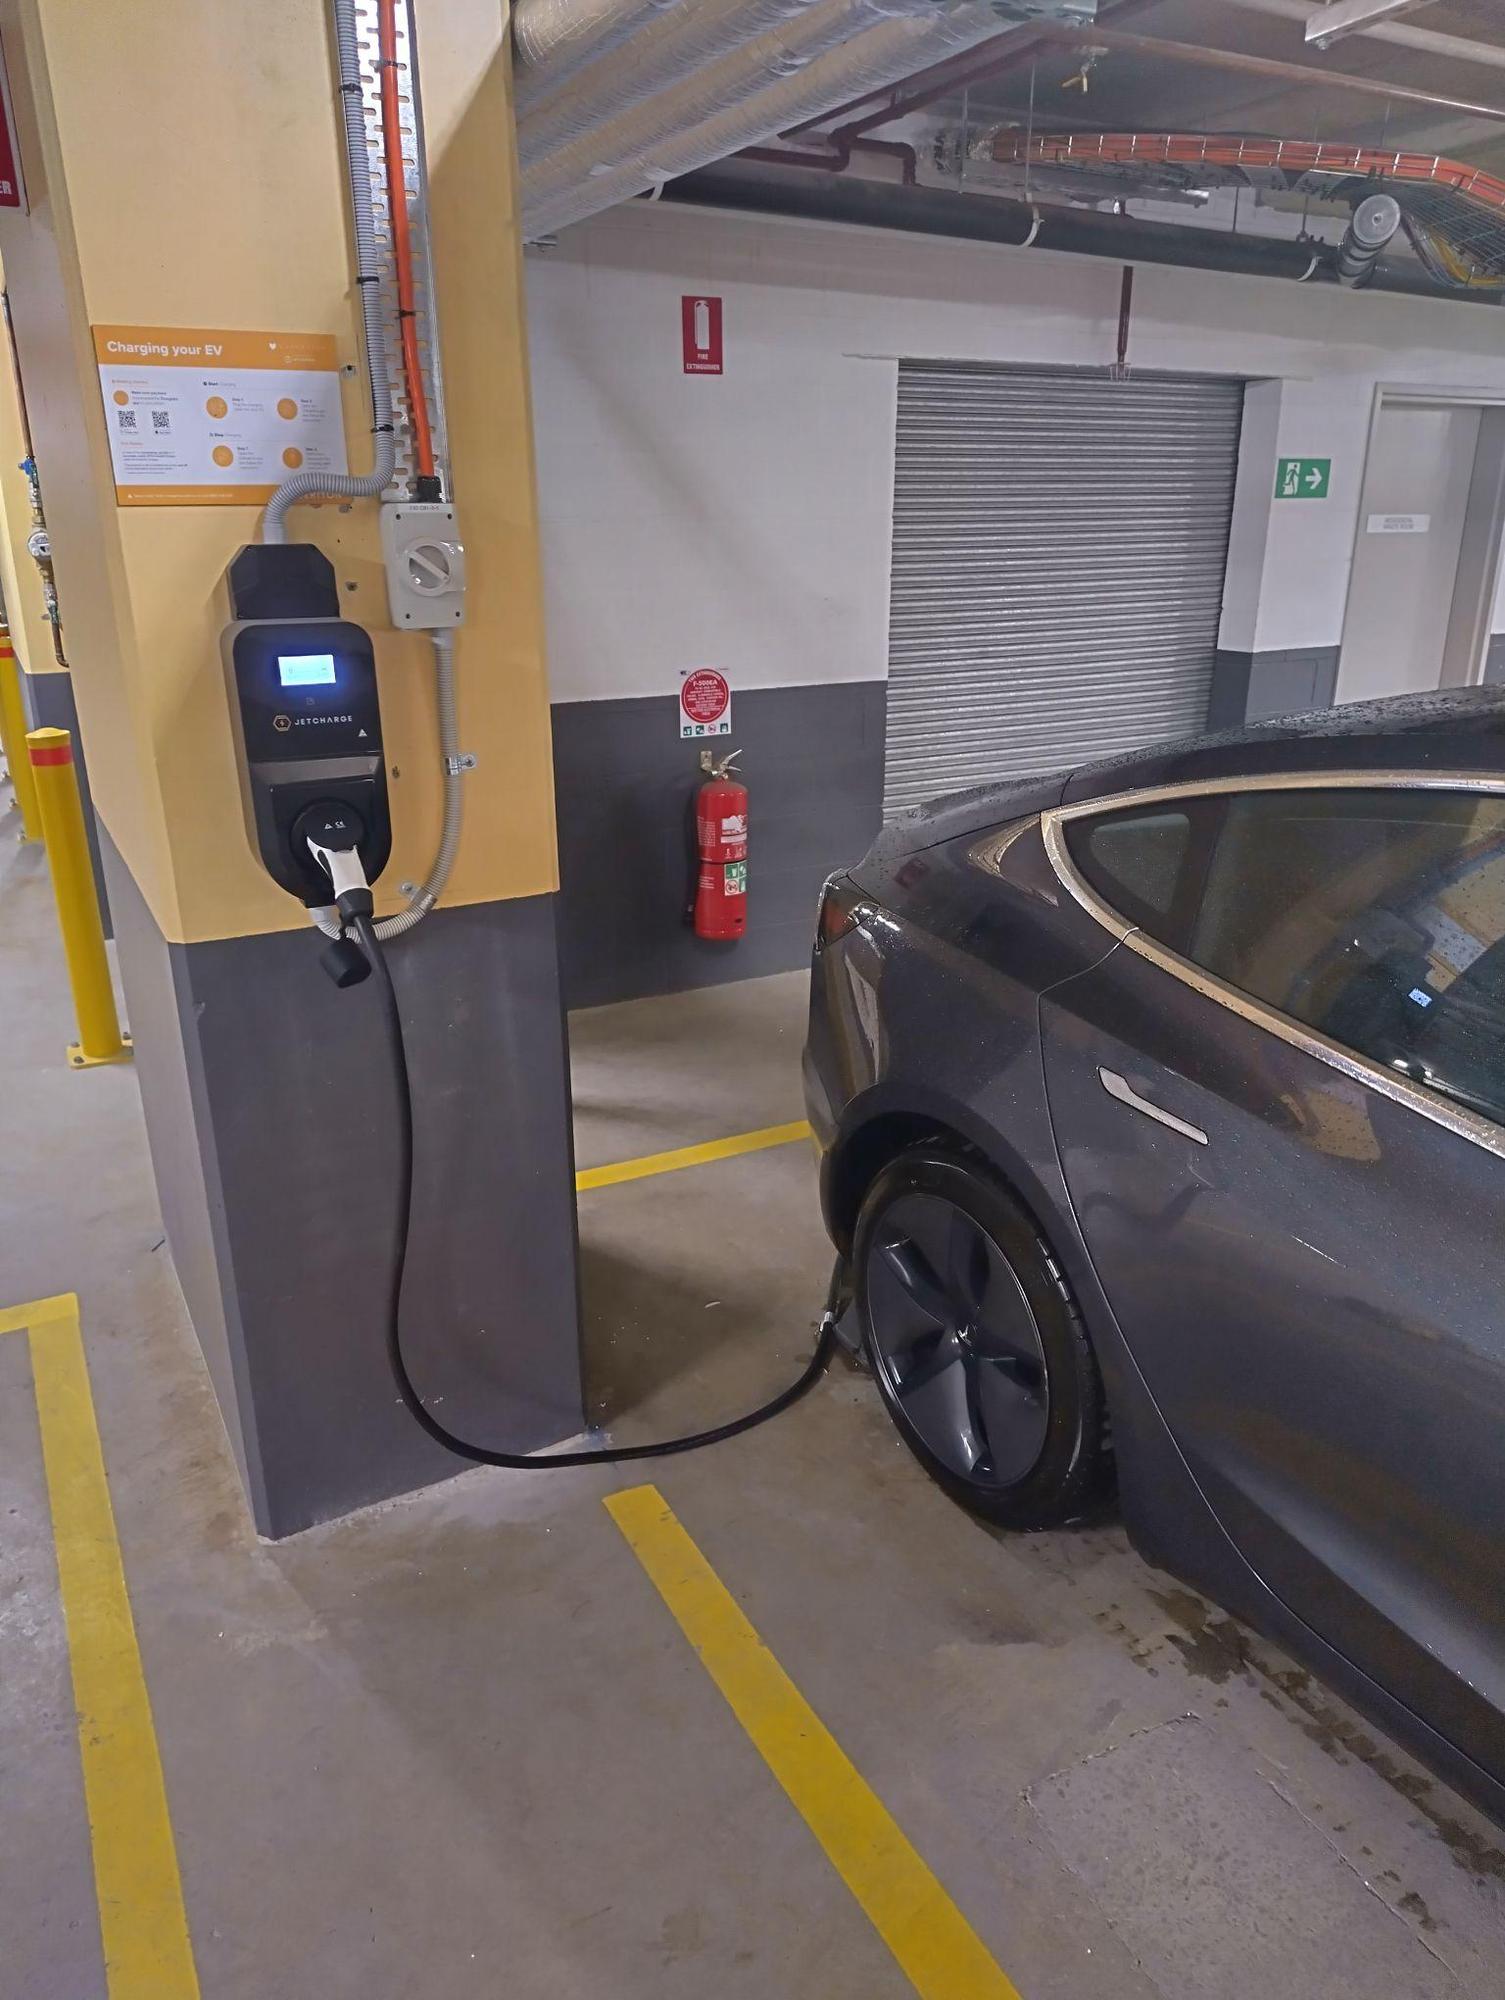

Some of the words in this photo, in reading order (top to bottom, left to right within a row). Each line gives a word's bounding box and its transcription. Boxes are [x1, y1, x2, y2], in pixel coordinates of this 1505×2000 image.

[106, 340, 169, 356] Charging
[172, 344, 202, 357] your
[205, 344, 223, 356] EV
[294, 715, 353, 726] JETCHARGE
